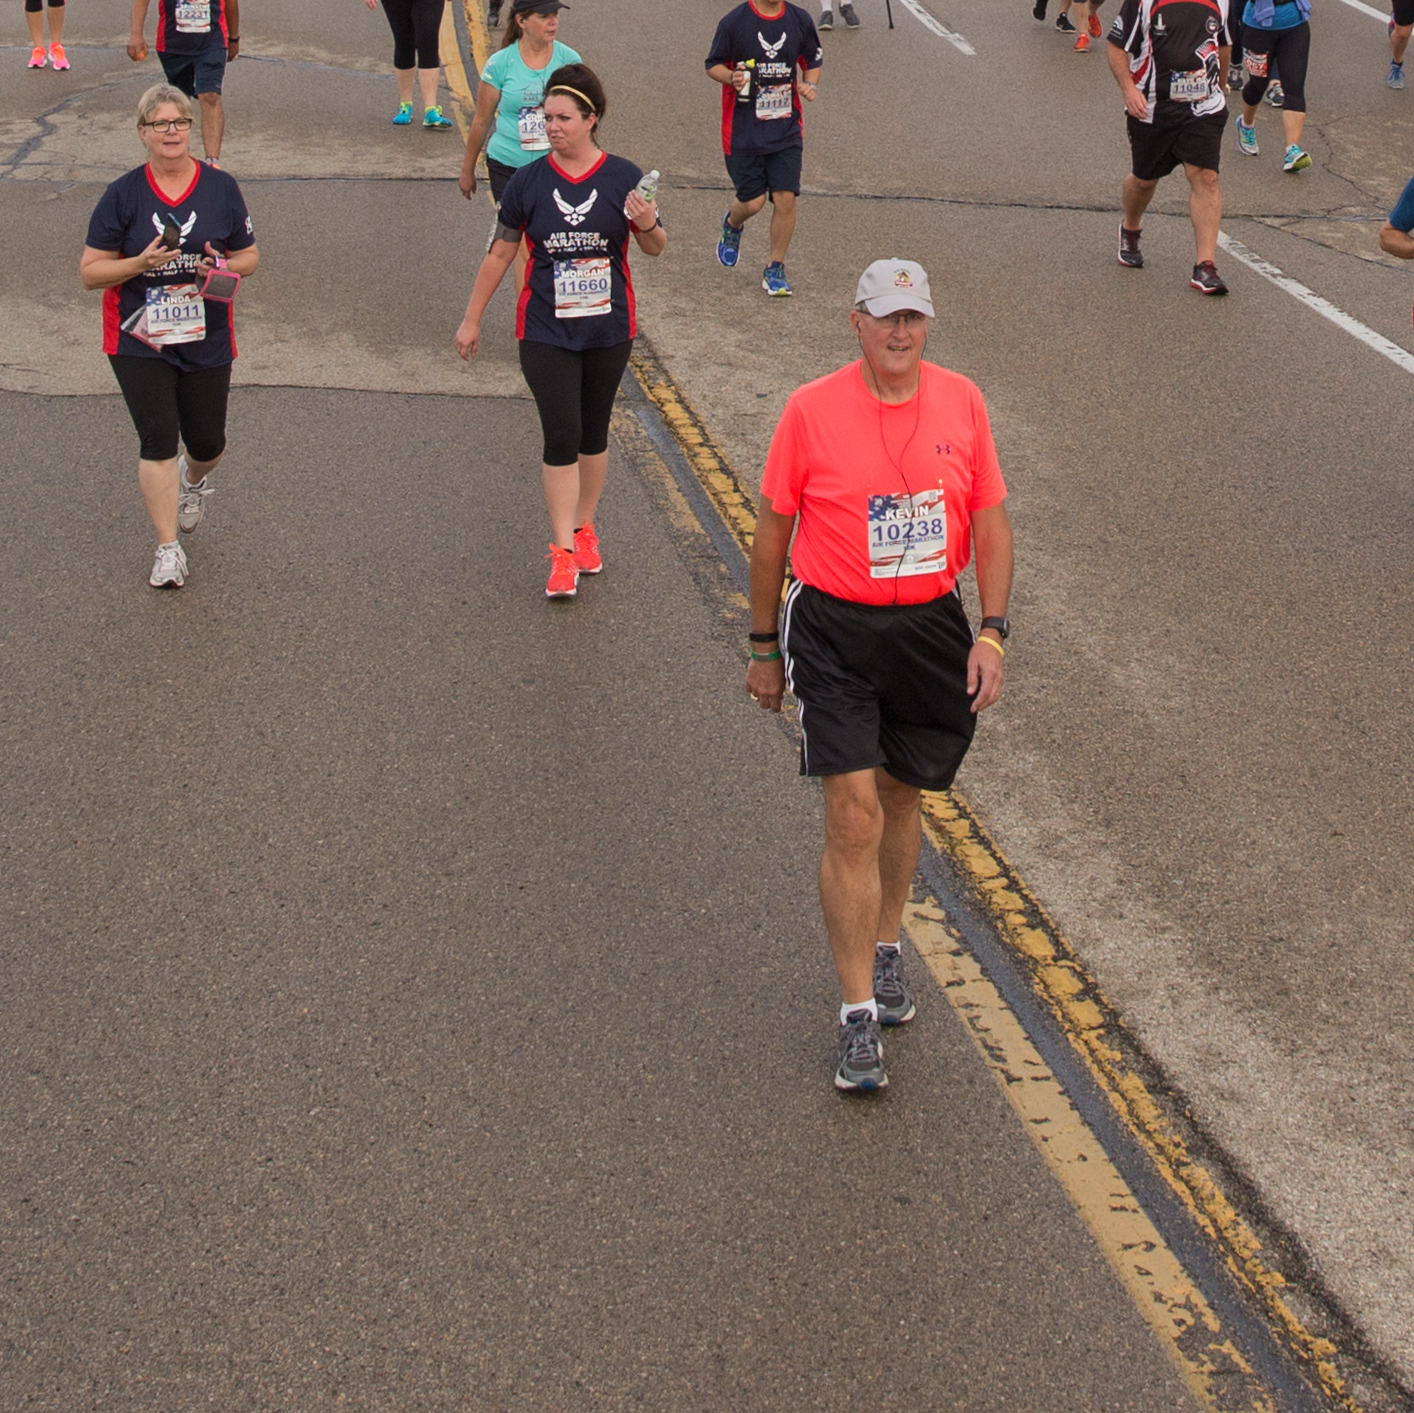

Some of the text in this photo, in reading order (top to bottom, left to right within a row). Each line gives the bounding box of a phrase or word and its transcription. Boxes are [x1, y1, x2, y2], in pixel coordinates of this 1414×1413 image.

[568, 232, 600, 240] FORCE
[543, 239, 609, 248] MARATHON
[176, 253, 203, 261] ORCE
[561, 269, 604, 278] MORGAN
[559, 278, 607, 293] 11660
[161, 295, 191, 305] LINDA
[152, 305, 200, 319] 11011
[886, 505, 929, 520] KEVIN
[873, 518, 942, 541] 10238
